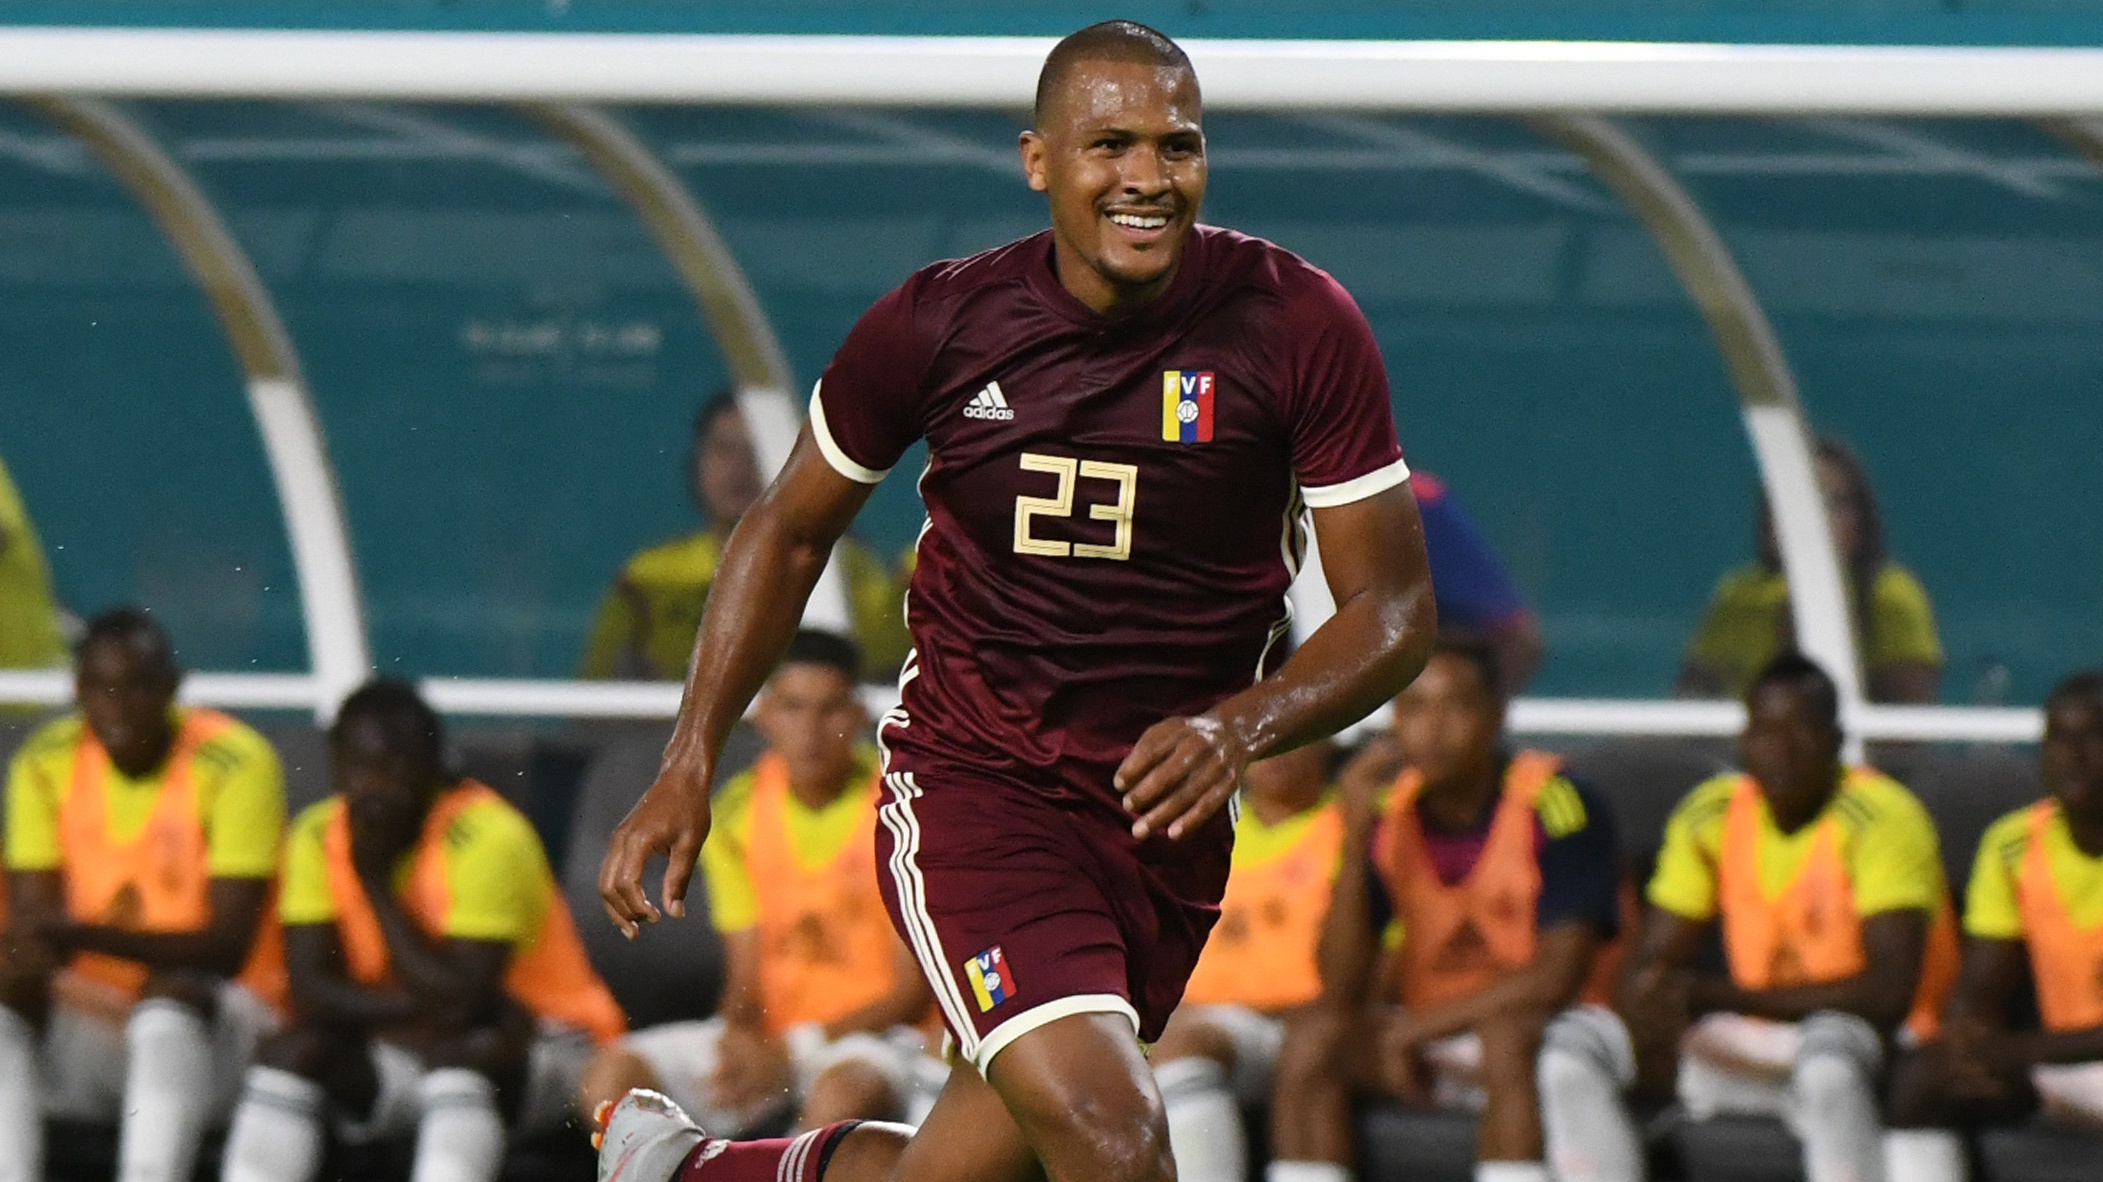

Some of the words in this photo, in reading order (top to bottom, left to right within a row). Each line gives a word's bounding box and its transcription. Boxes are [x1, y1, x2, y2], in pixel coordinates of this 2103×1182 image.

[1166, 376, 1212, 395] FVF
[963, 406, 1015, 420] adidas
[1013, 452, 1138, 561] 23
